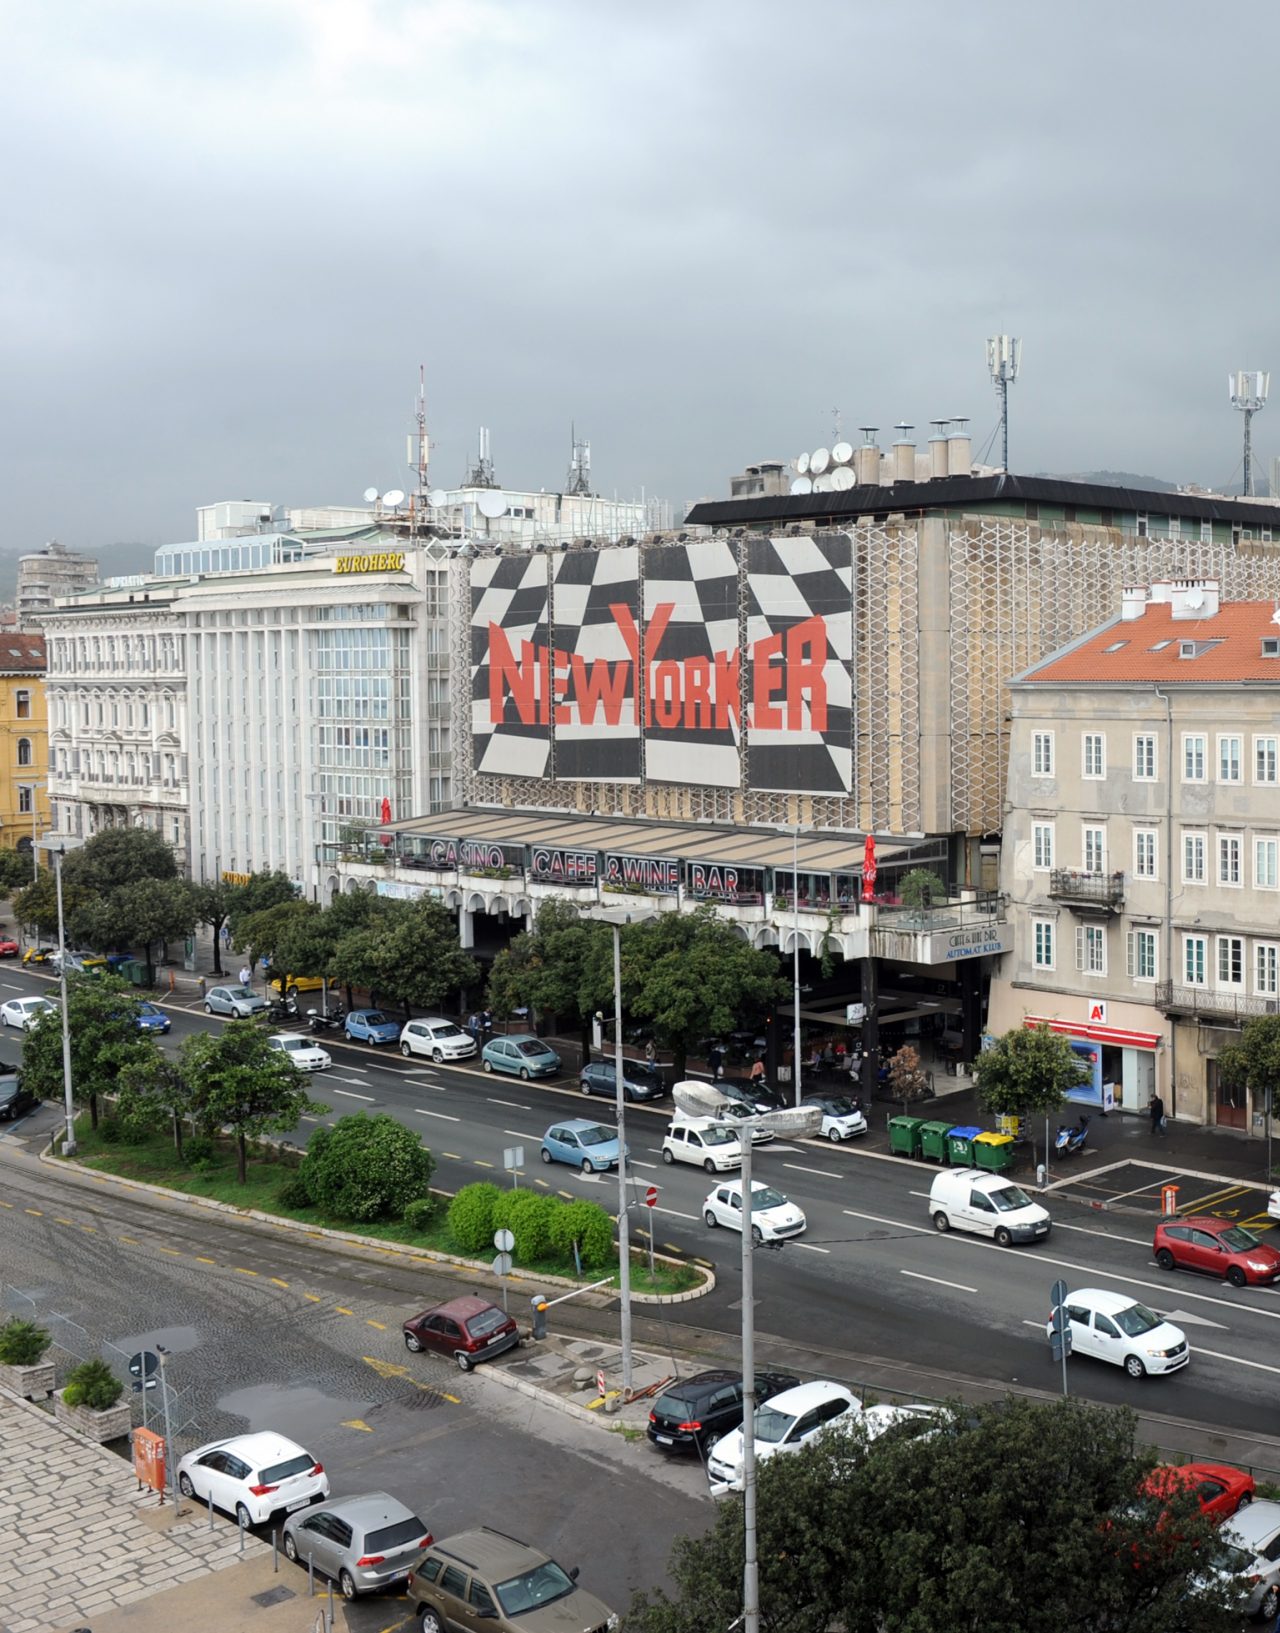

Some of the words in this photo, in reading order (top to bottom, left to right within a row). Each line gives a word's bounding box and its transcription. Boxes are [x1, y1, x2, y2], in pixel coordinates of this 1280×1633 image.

[335, 552, 405, 574] EUROHERC
[489, 620, 630, 726] NEW
[608, 602, 828, 732] YORKER
[430, 840, 505, 871] CASINO
[533, 850, 597, 884] CAFFE
[622, 858, 678, 892] WINE
[692, 864, 739, 899] BAR
